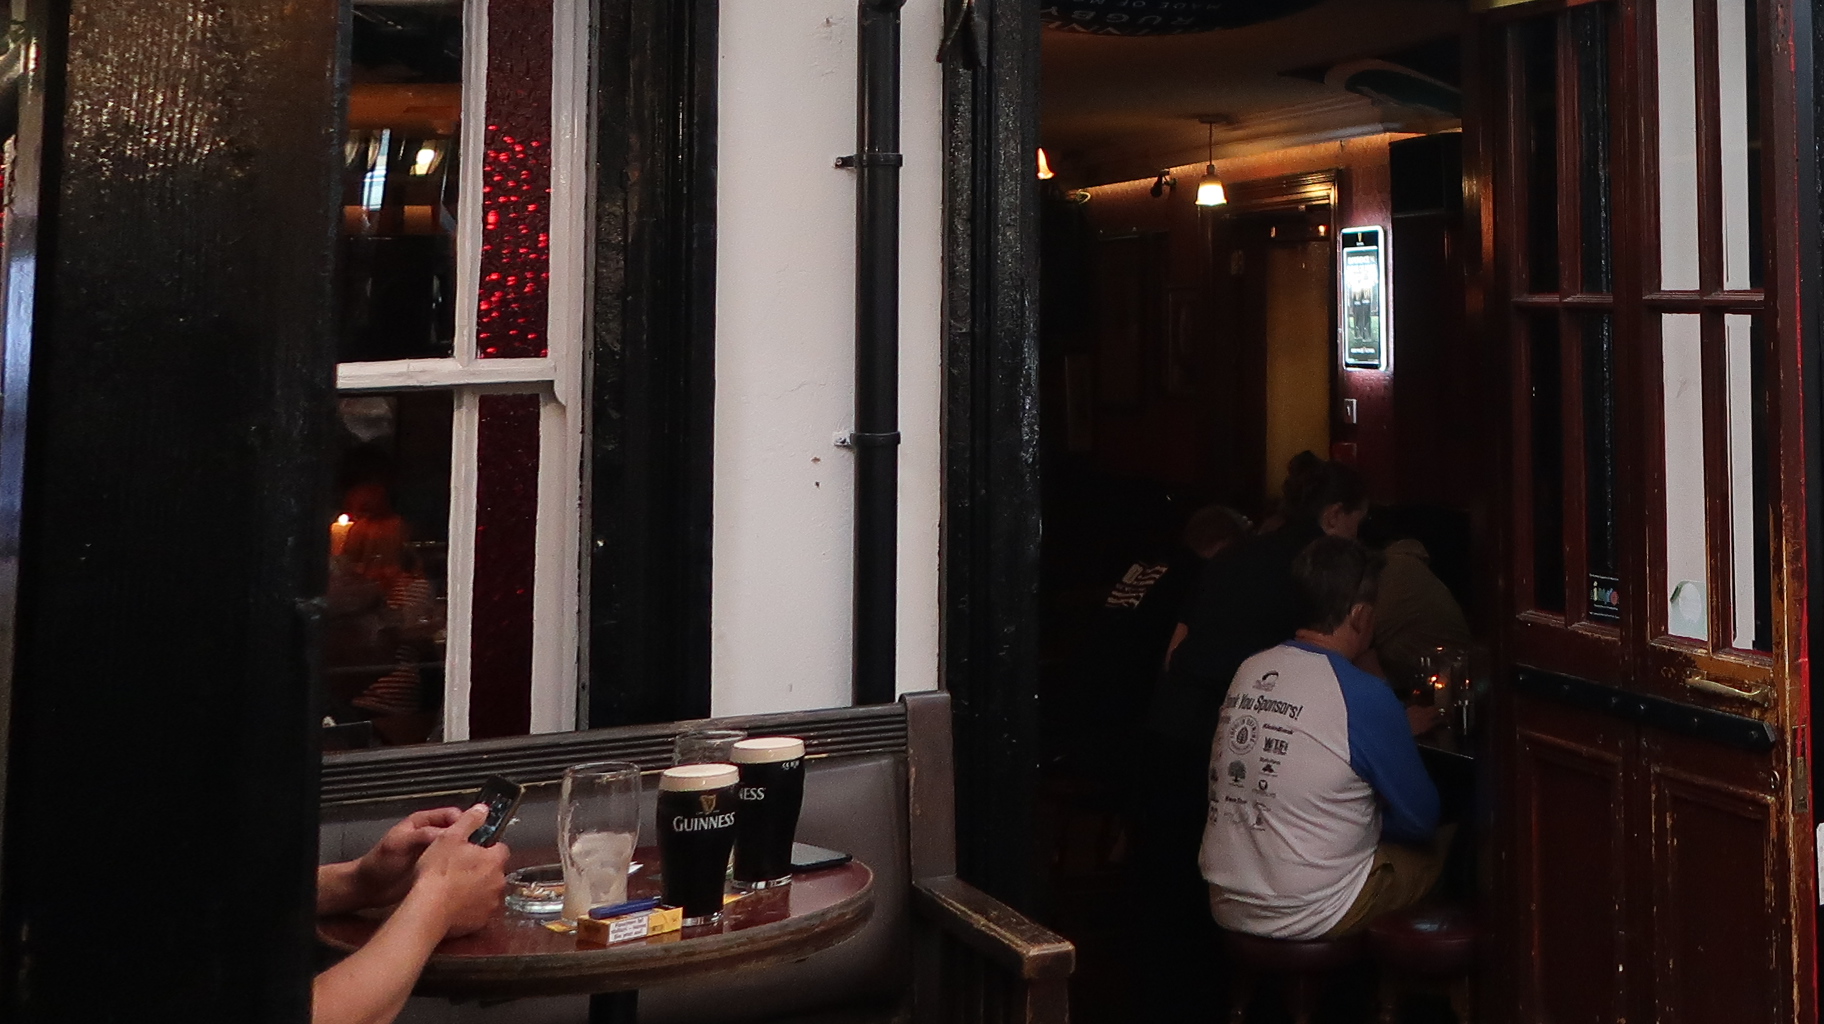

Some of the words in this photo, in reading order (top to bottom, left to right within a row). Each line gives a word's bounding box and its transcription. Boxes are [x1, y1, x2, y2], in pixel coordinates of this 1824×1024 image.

[1040, 5, 1195, 26] RUGBY
[1238, 693, 1256, 710] You
[1253, 695, 1304, 721] Sponsors!
[673, 812, 736, 832] GUINNESS
